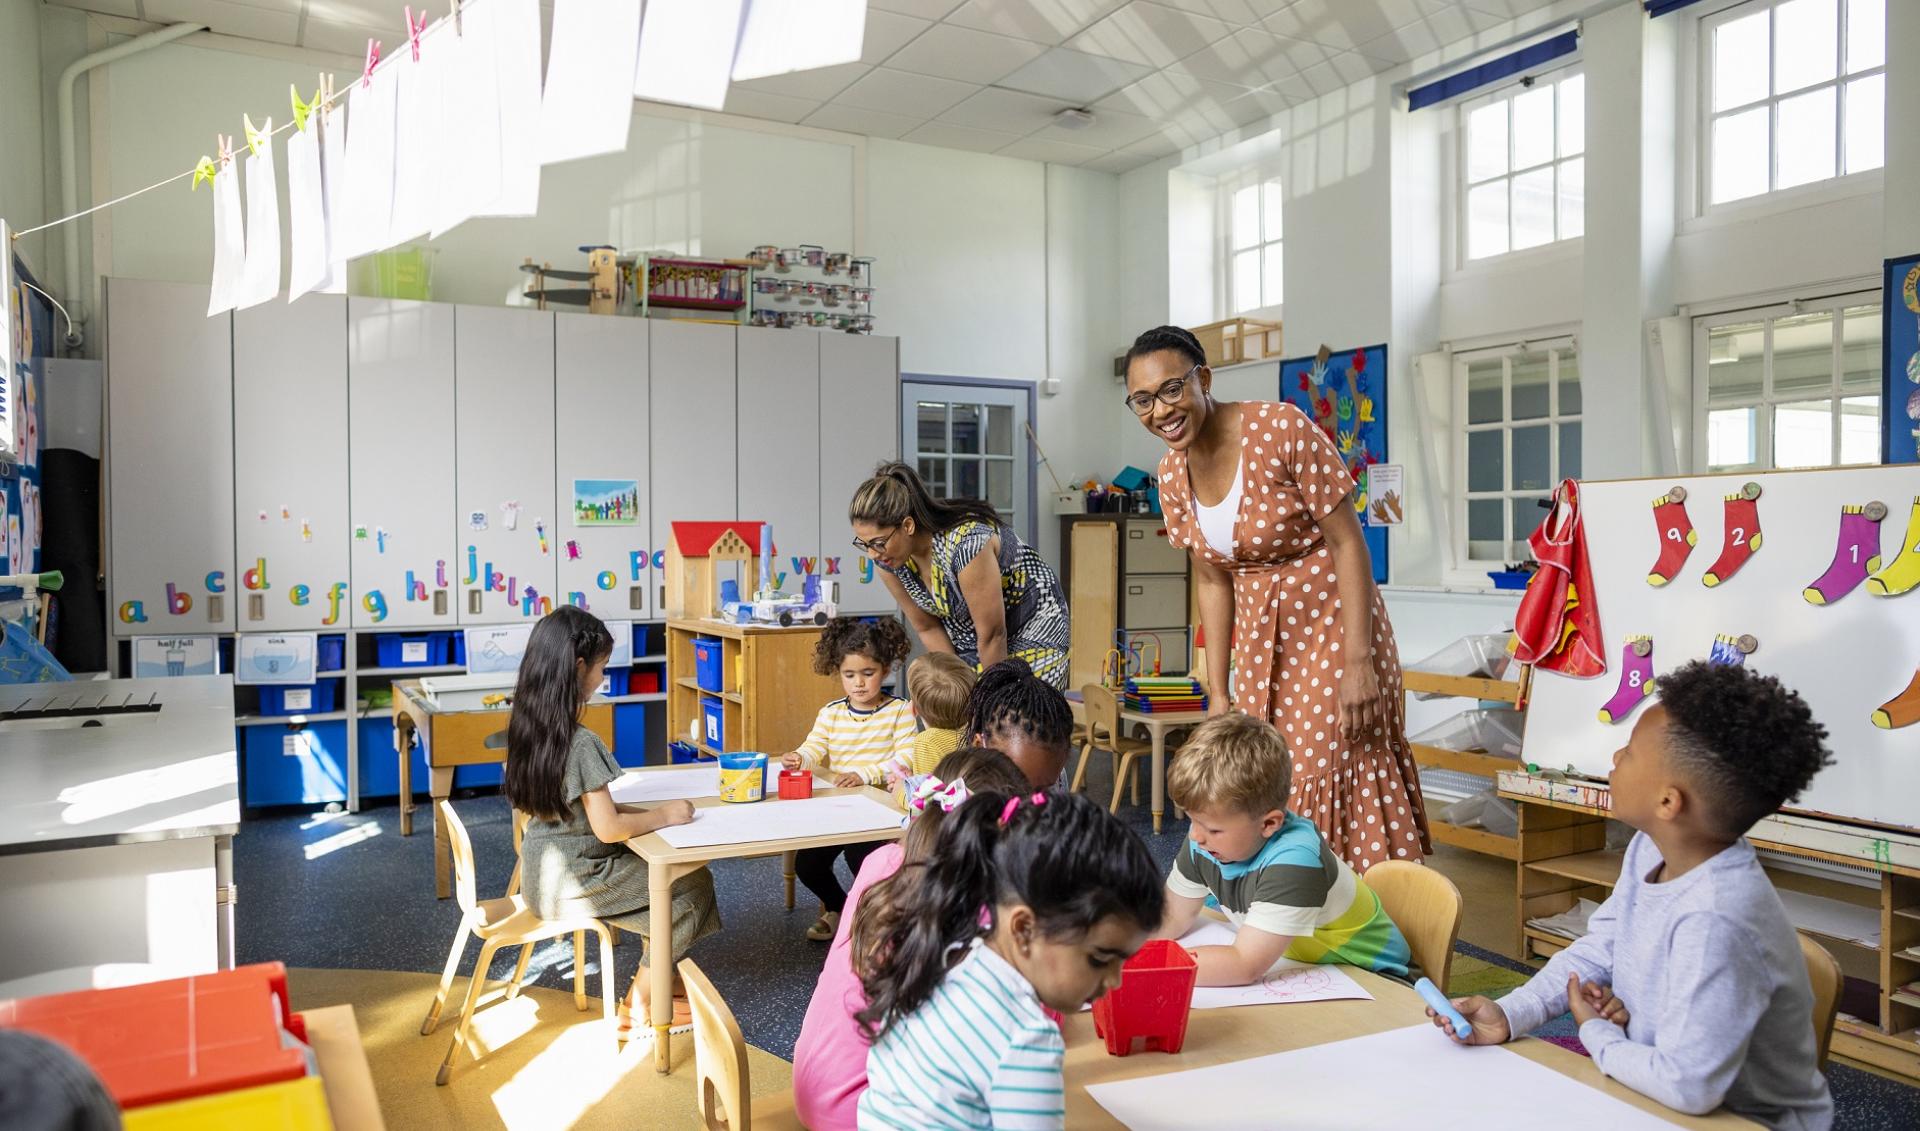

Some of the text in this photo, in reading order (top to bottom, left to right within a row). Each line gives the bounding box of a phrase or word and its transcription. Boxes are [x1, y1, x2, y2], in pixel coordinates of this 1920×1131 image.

[1667, 527, 1682, 543] 9
[1731, 527, 1745, 546] 2
[1849, 544, 1858, 564] 1
[119, 601, 148, 624] a
[166, 582, 193, 615] b
[205, 571, 225, 593] c
[243, 558, 270, 590] d
[289, 584, 310, 606] e
[322, 582, 348, 625] f
[362, 589, 388, 623] g
[406, 571, 429, 602] h
[436, 559, 448, 588] i
[463, 545, 477, 585] j
[484, 562, 507, 592] k
[508, 576, 519, 606] l
[597, 571, 617, 591] o
[629, 550, 649, 581] p
[791, 556, 817, 576] w
[825, 556, 841, 575] x
[157, 639, 194, 649] half full
[1628, 670, 1641, 687] 8
